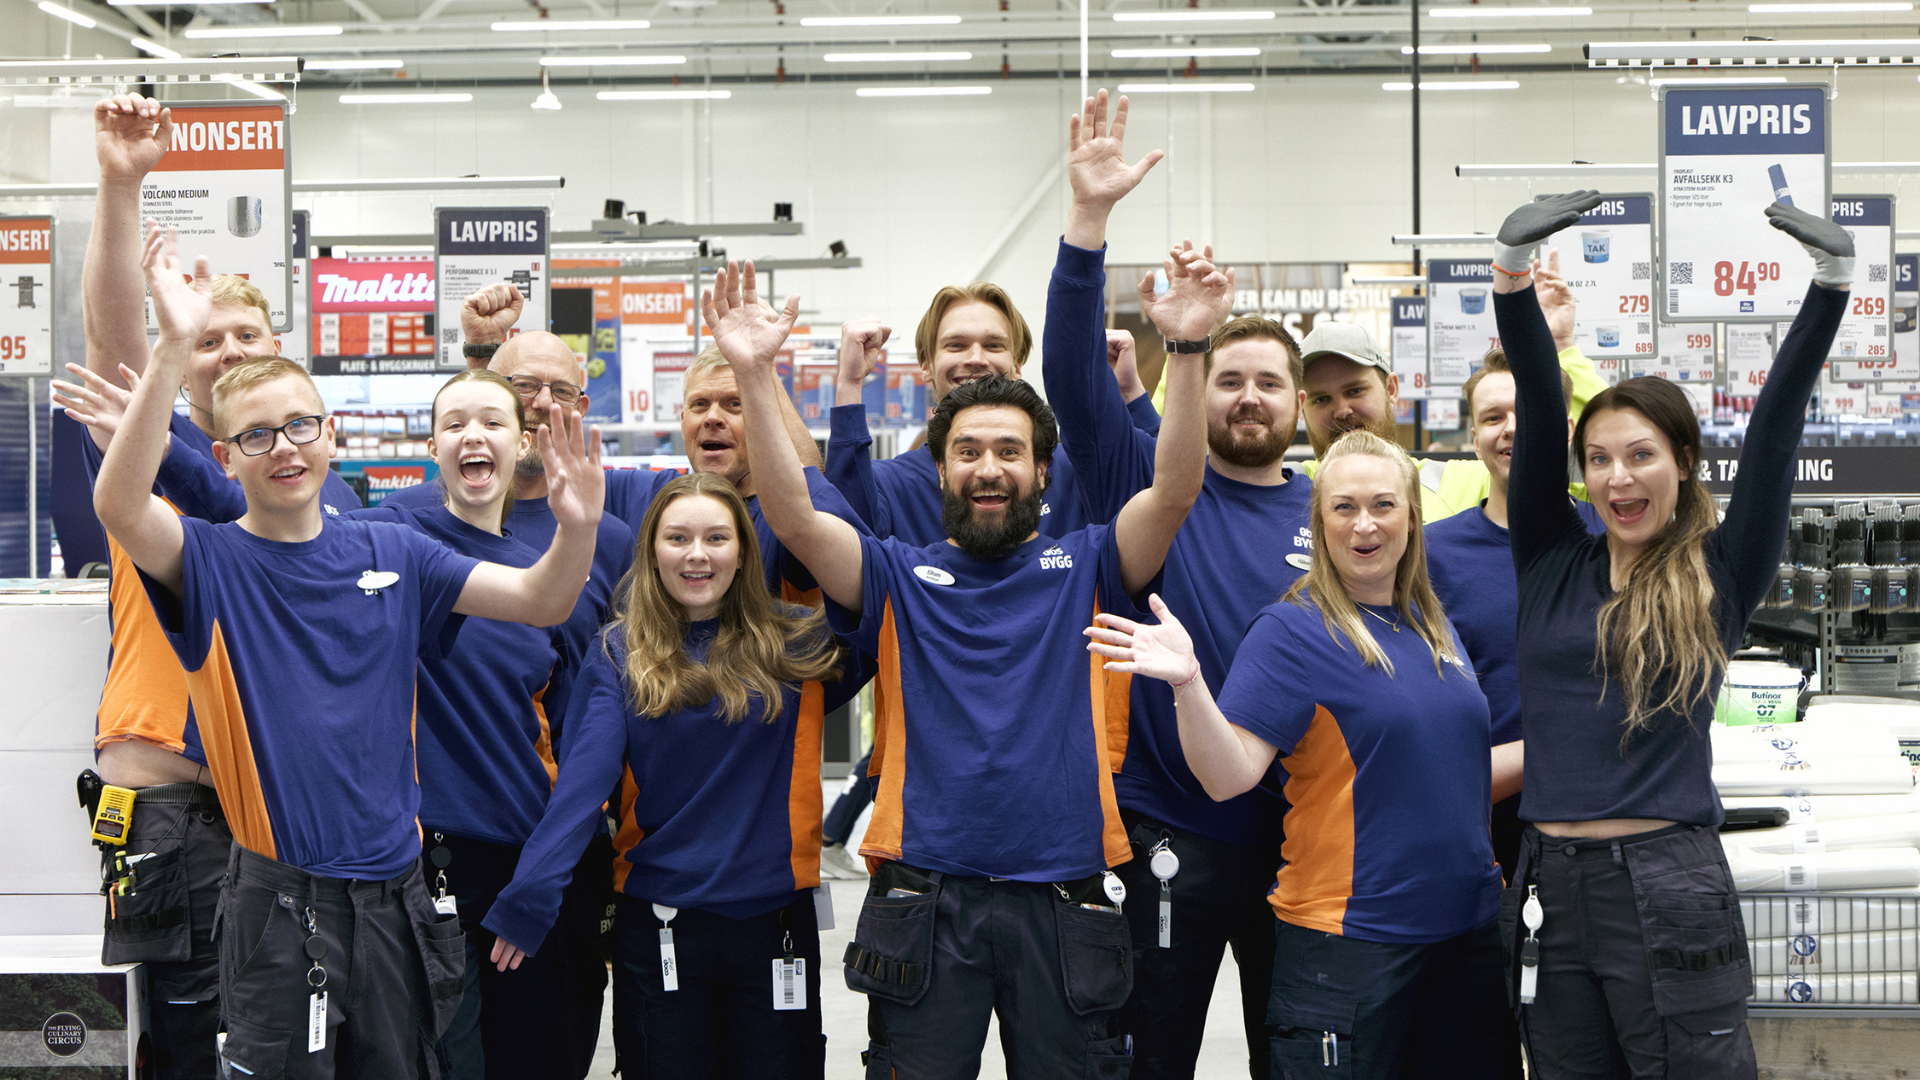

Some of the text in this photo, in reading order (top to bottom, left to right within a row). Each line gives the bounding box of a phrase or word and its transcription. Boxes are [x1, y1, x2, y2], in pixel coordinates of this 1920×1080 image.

[1682, 104, 1811, 135] LAVPRIS
[153, 120, 284, 152] NONSERT
[1673, 174, 1733, 184] AVFALLSEKK K3
[142, 189, 209, 199] VOLCANO MEDIUM
[451, 220, 538, 243] LAVPRIS
[1714, 260, 1780, 297] 84 90
[1261, 289, 1297, 310] KAN
[1300, 289, 1324, 309] DU
[1619, 294, 1650, 313] 279
[1853, 297, 1885, 316] 269
[1, 336, 26, 361] 95
[1636, 343, 1652, 353] 689
[1687, 334, 1712, 349] 599
[1868, 345, 1885, 355] 285
[1748, 370, 1769, 386] 46
[628, 390, 648, 412] 10
[1698, 459, 1712, 482] &
[1039, 554, 1073, 570] BYGG
[1752, 691, 1782, 700] Butinox
[1756, 704, 1776, 716] 07
[48, 1036, 82, 1044] CIRCUS
